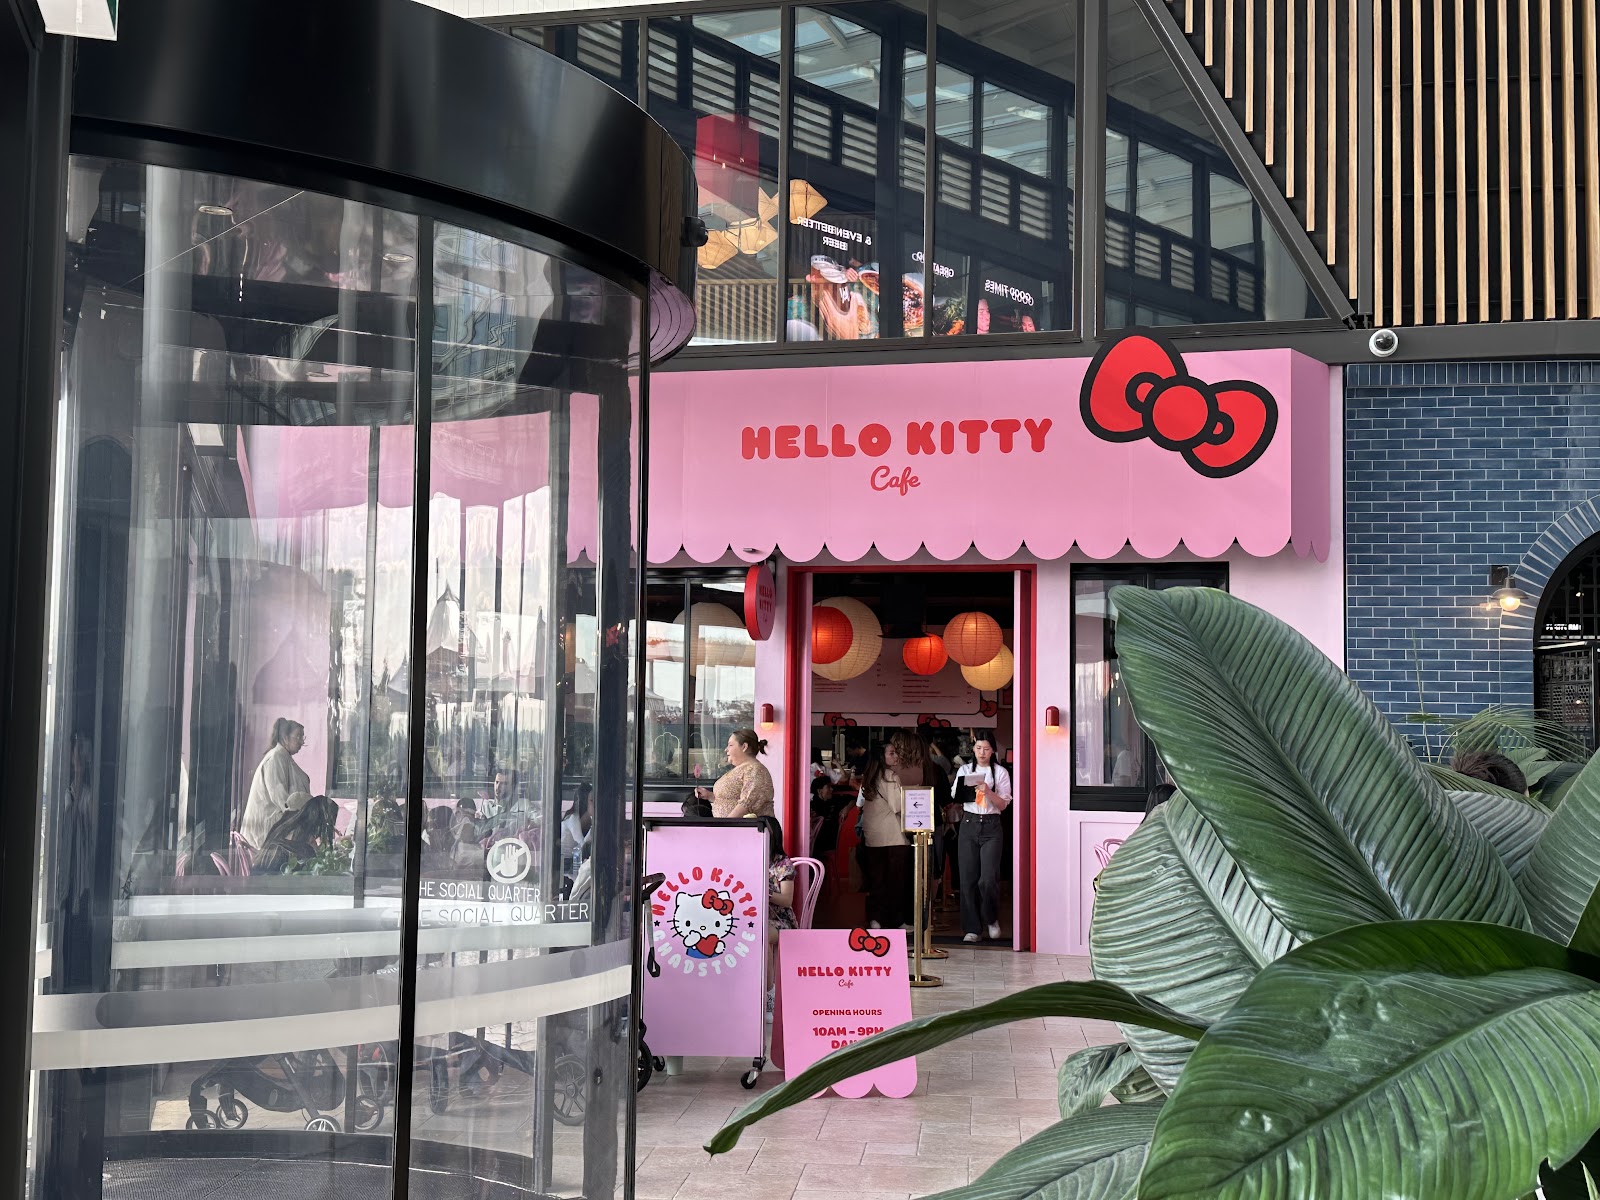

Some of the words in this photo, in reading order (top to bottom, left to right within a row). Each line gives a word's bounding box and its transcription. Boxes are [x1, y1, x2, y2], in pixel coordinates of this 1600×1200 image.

[741, 423, 892, 460] HELLO
[906, 418, 1053, 455] KITTY
[870, 465, 921, 497] Cafe
[419, 881, 435, 897] HE
[439, 882, 484, 900] SOCIAL
[488, 884, 541, 903] QUARTER
[652, 866, 703, 916] HELLO
[393, 910, 431, 928] TE
[438, 907, 503, 926] SOCIAL
[511, 902, 589, 922] QUARTER
[653, 929, 756, 977] CHADSTONE
[797, 966, 845, 977] HELLO
[848, 966, 892, 976] KITTY
[838, 978, 854, 988] Cafe
[812, 1026, 847, 1037] 10AM
